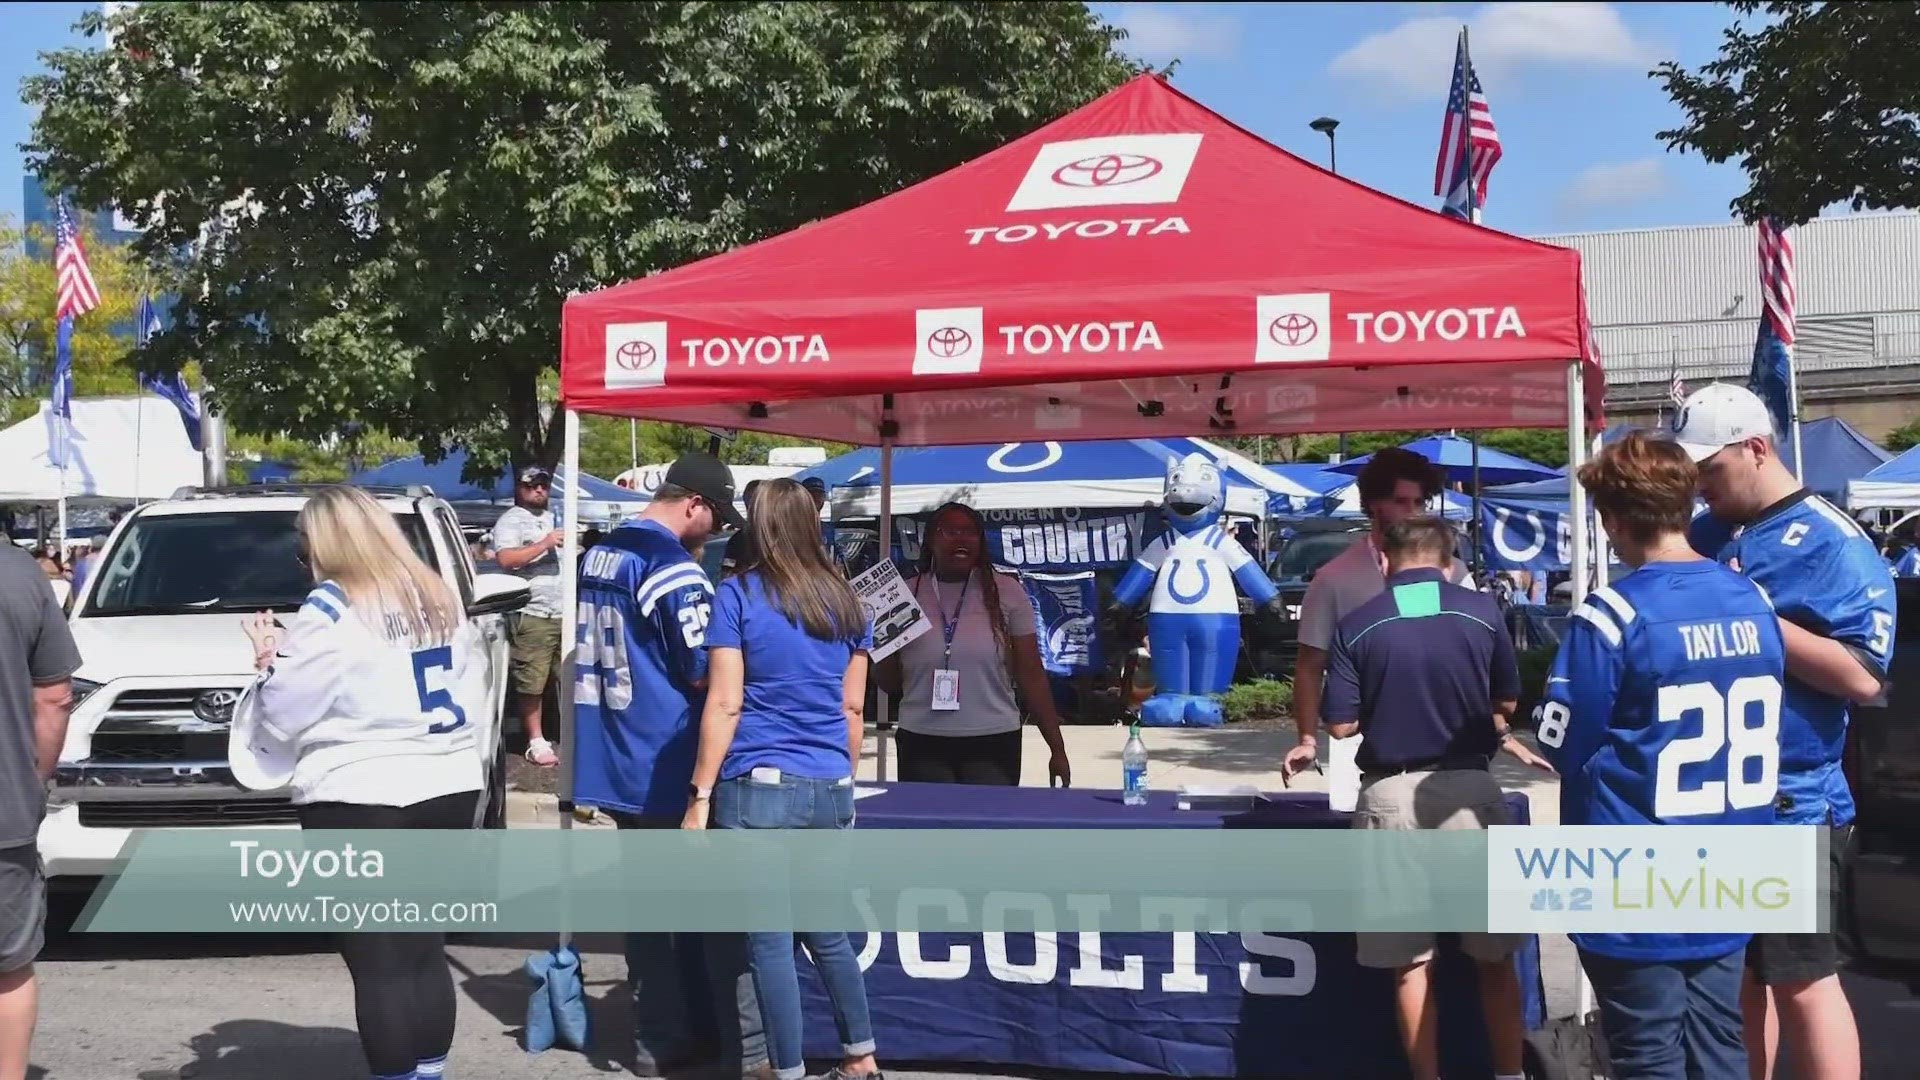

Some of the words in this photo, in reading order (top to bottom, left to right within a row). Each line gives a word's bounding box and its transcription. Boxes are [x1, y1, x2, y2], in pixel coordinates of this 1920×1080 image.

[965, 217, 1190, 245] TOYOTA
[999, 321, 1164, 354] TOYOTA
[1347, 306, 1526, 343] TOYOTA
[681, 334, 830, 367] TOYOTA
[979, 507, 1036, 522] YOU'RE
[1038, 507, 1055, 521] IN
[1001, 512, 1146, 565] COUNTRY
[1679, 620, 1761, 661] TAYLOR
[412, 645, 466, 734] 5
[1655, 675, 1783, 818] 28
[896, 887, 1317, 996] COLTS
